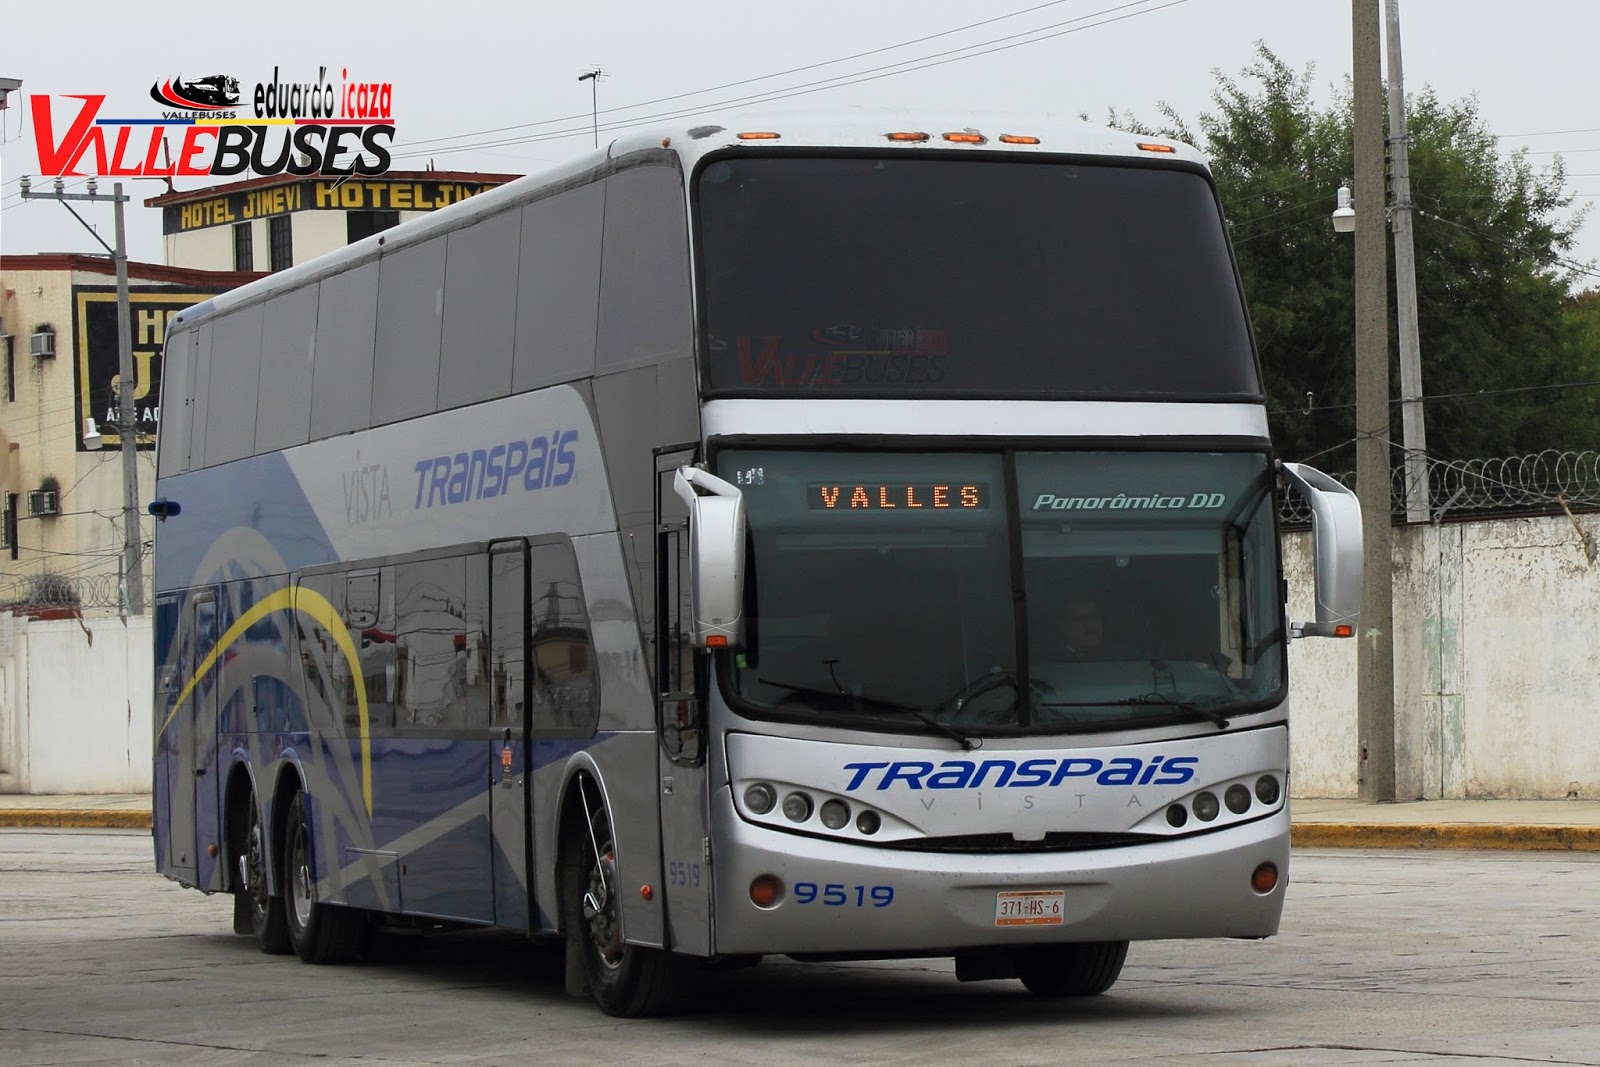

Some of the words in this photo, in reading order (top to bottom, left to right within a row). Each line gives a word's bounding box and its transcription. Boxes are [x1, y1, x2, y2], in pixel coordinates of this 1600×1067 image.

[181, 198, 235, 230] HOTEL
[243, 184, 301, 219] JIMEVI
[315, 182, 433, 208] HOTEL
[820, 486, 978, 508] VALLES
[1033, 493, 1185, 510] Panorâmico
[1187, 493, 1226, 508] DD
[670, 861, 700, 889] 9519
[794, 882, 895, 908] 9519
[1001, 900, 1059, 915] 371-HS-6
